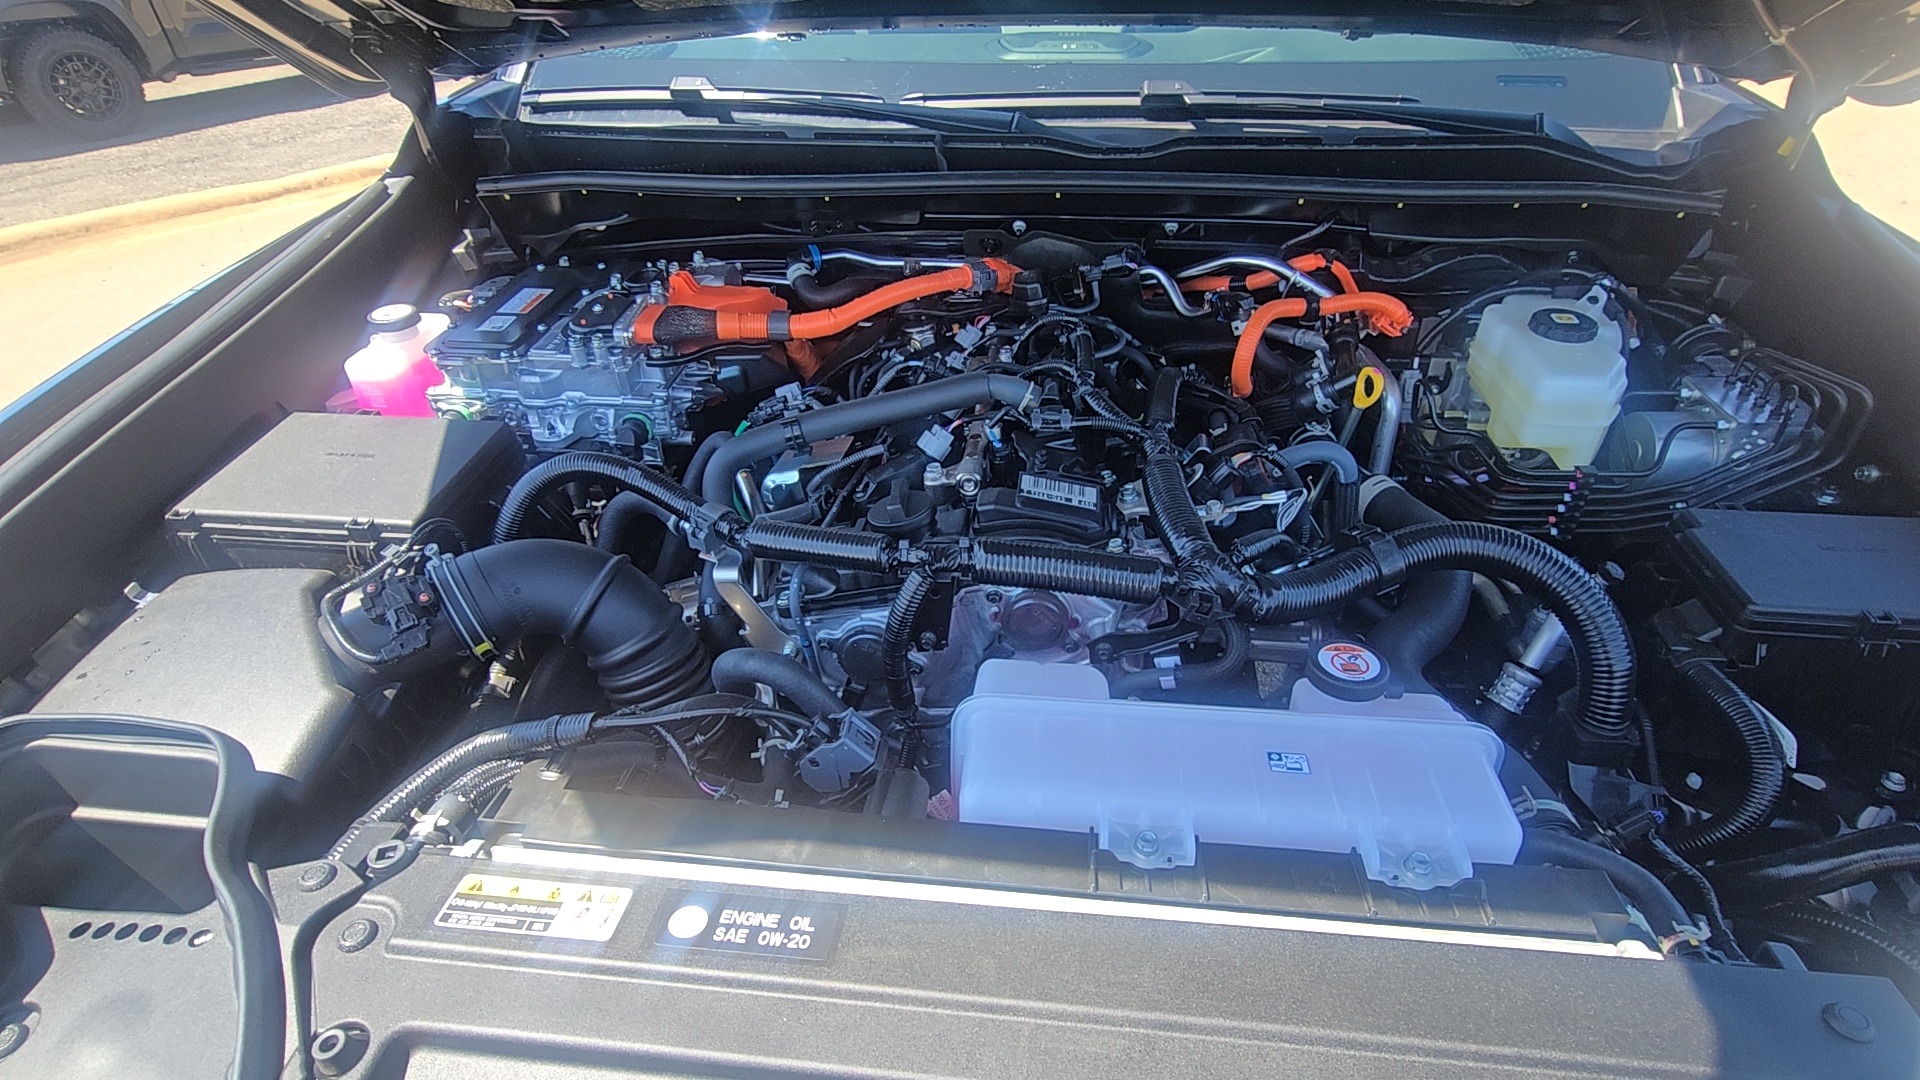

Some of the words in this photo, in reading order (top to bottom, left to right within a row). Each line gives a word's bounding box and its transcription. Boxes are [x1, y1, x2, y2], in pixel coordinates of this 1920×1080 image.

[719, 909, 781, 929] ENGINE
[789, 916, 815, 932] OIL
[712, 927, 750, 944] SAE
[757, 931, 811, 950] 0W-20
